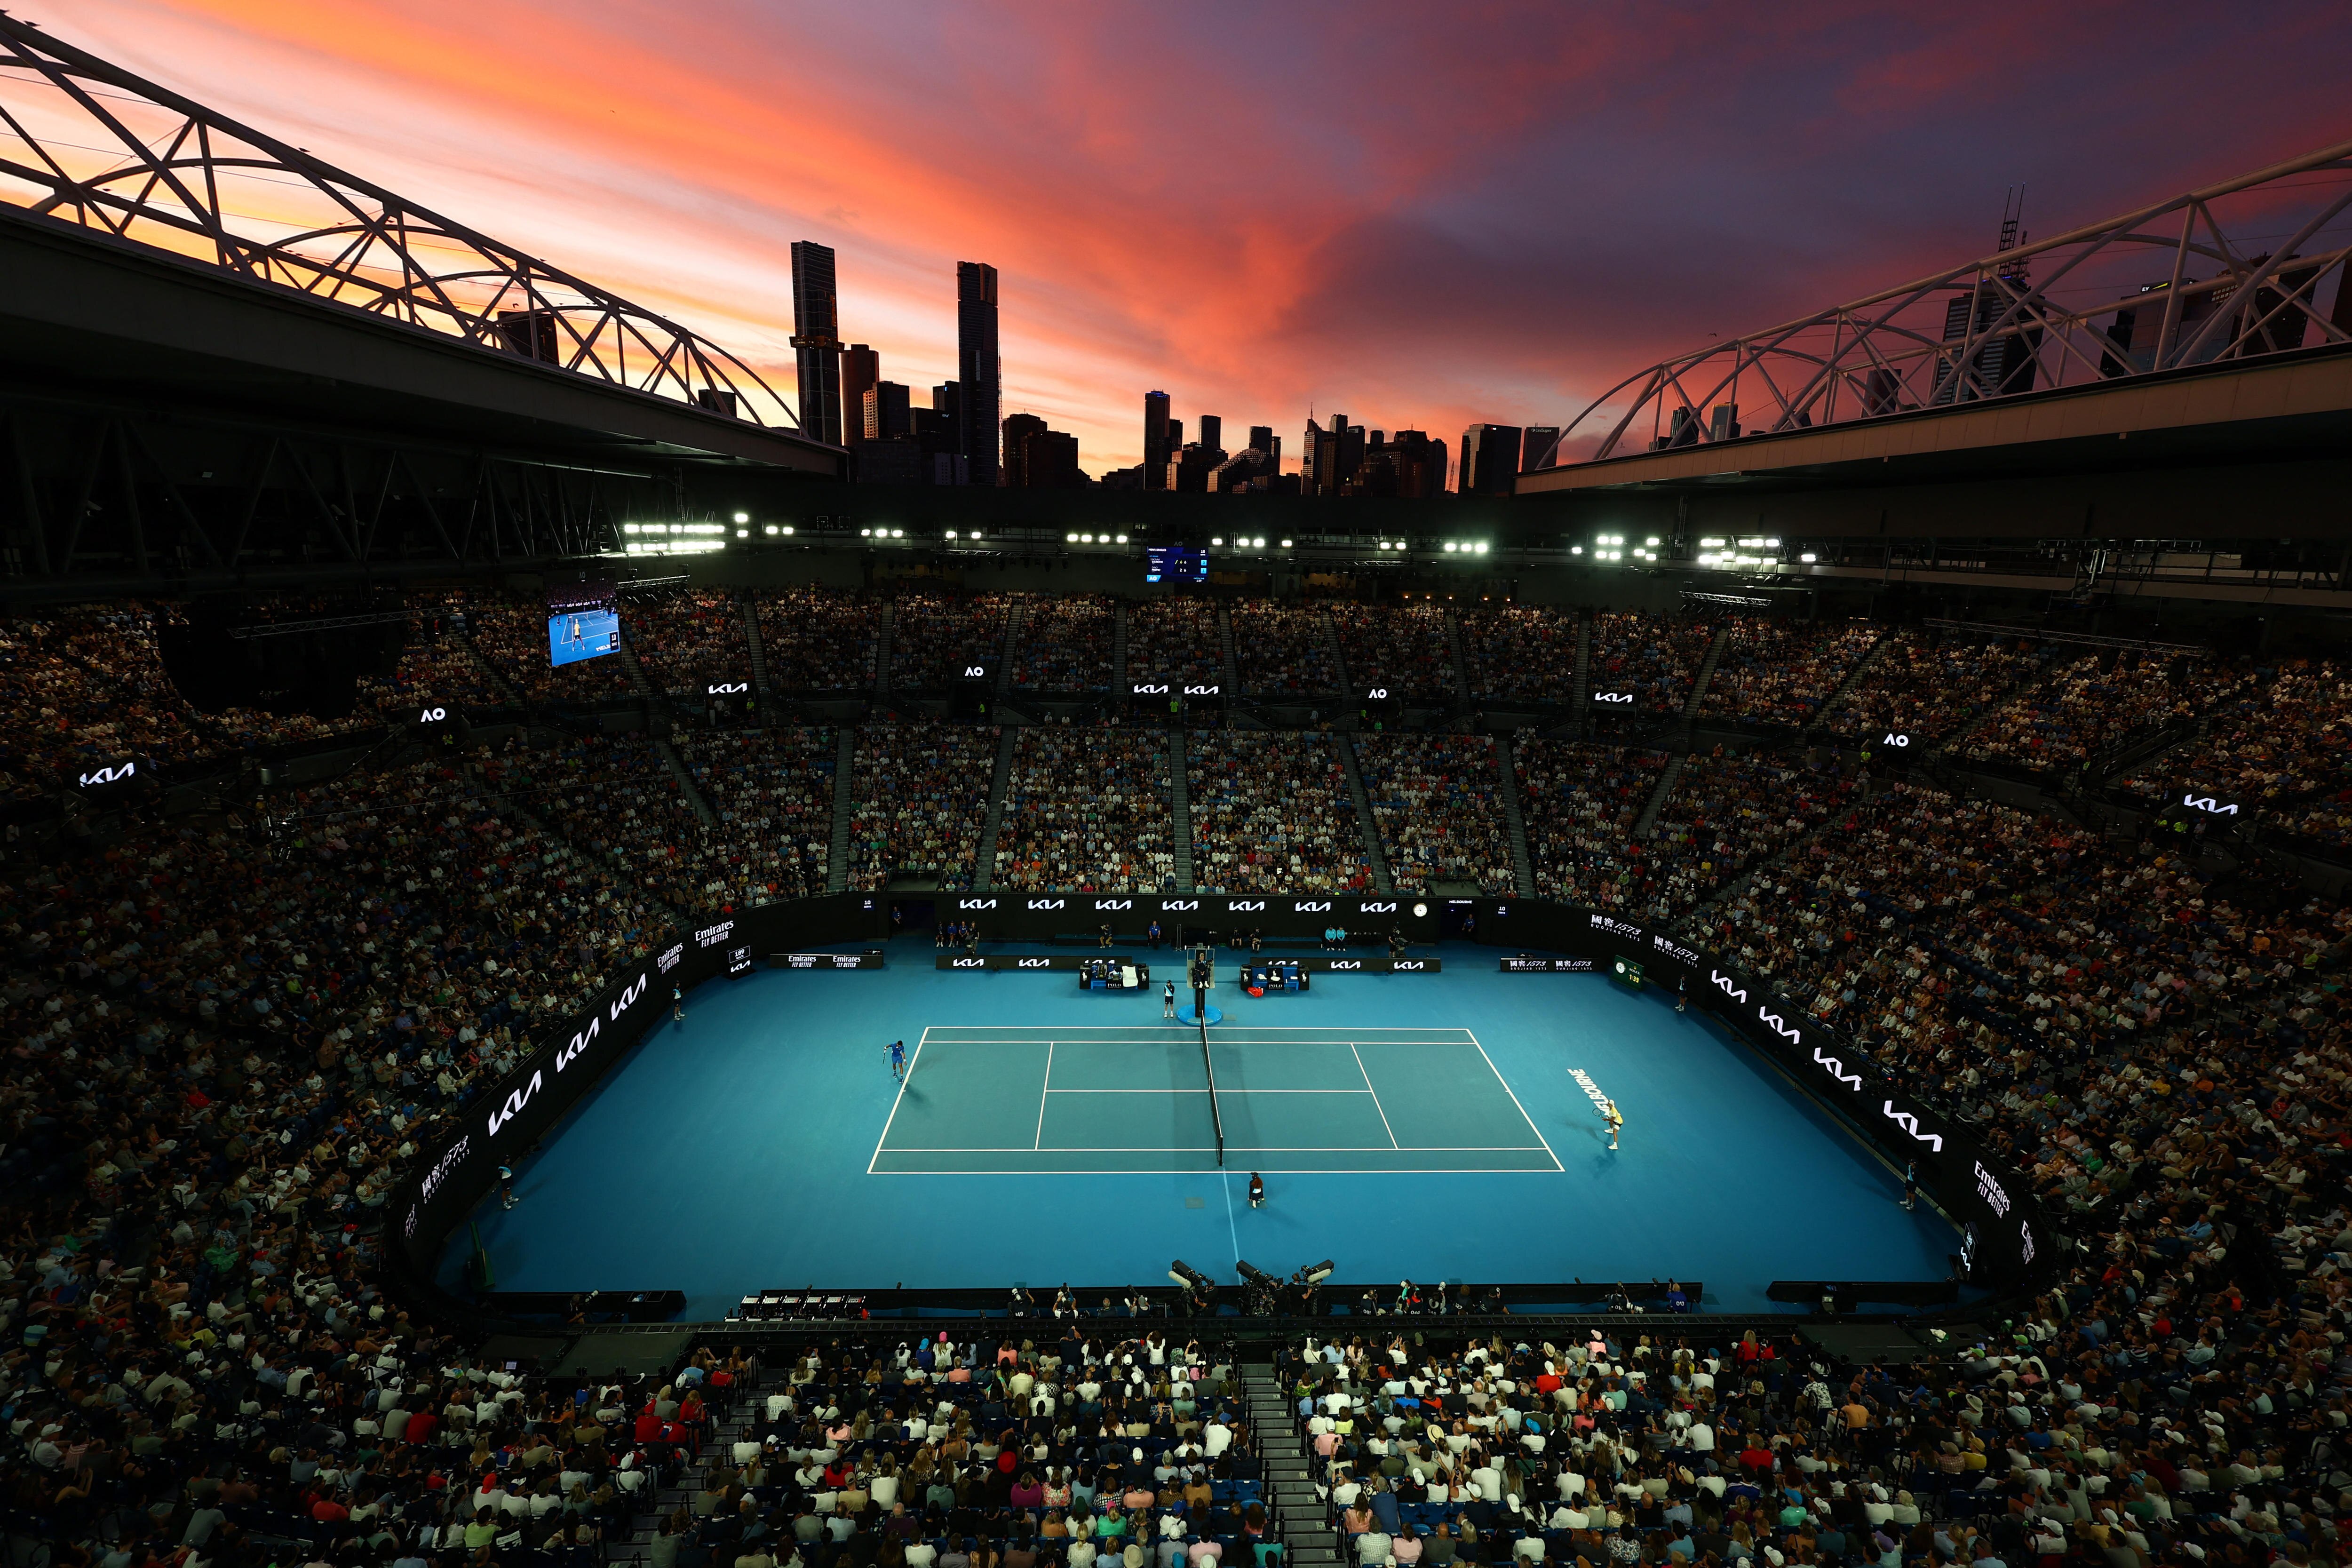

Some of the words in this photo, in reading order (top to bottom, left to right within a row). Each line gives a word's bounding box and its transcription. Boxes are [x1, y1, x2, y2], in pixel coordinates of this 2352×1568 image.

[964, 667, 984, 677] AO
[709, 683, 747, 694] KIA
[1134, 685, 1168, 693] KIA
[1184, 685, 1219, 694] KIA
[1368, 689, 1387, 699] AO
[1595, 692, 1633, 703] KIA
[421, 708, 445, 723] AO
[1883, 733, 1909, 747] AO
[79, 762, 134, 787] KIA
[2184, 794, 2238, 815] KIA
[960, 899, 996, 909] KIA
[1028, 899, 1065, 909] KIA
[1095, 900, 1132, 910] KIA
[1162, 900, 1198, 910] KIA
[1229, 901, 1265, 911] KIA
[1295, 901, 1331, 912] KIA
[1360, 902, 1397, 912] KIA
[695, 920, 734, 941] Emirates
[701, 938, 710, 948] FLY
[711, 931, 728, 945] BETTER
[658, 942, 683, 968] Emirates
[953, 958, 984, 967] KIA
[1331, 961, 1361, 969] KIA
[1629, 974, 1639, 983] 1:39
[1711, 970, 1747, 1003] KIA
[611, 973, 646, 1021] KIA
[1759, 1006, 1800, 1044] KIA
[556, 1011, 599, 1073] KIA
[1813, 1047, 1861, 1091] KIA
[488, 1065, 542, 1137] KIA
[1883, 1100, 1943, 1152] KIA
[1974, 1160, 2010, 1211] Emirates
[1977, 1182, 1989, 1198] FLY
[1987, 1192, 2004, 1218] BETTER
